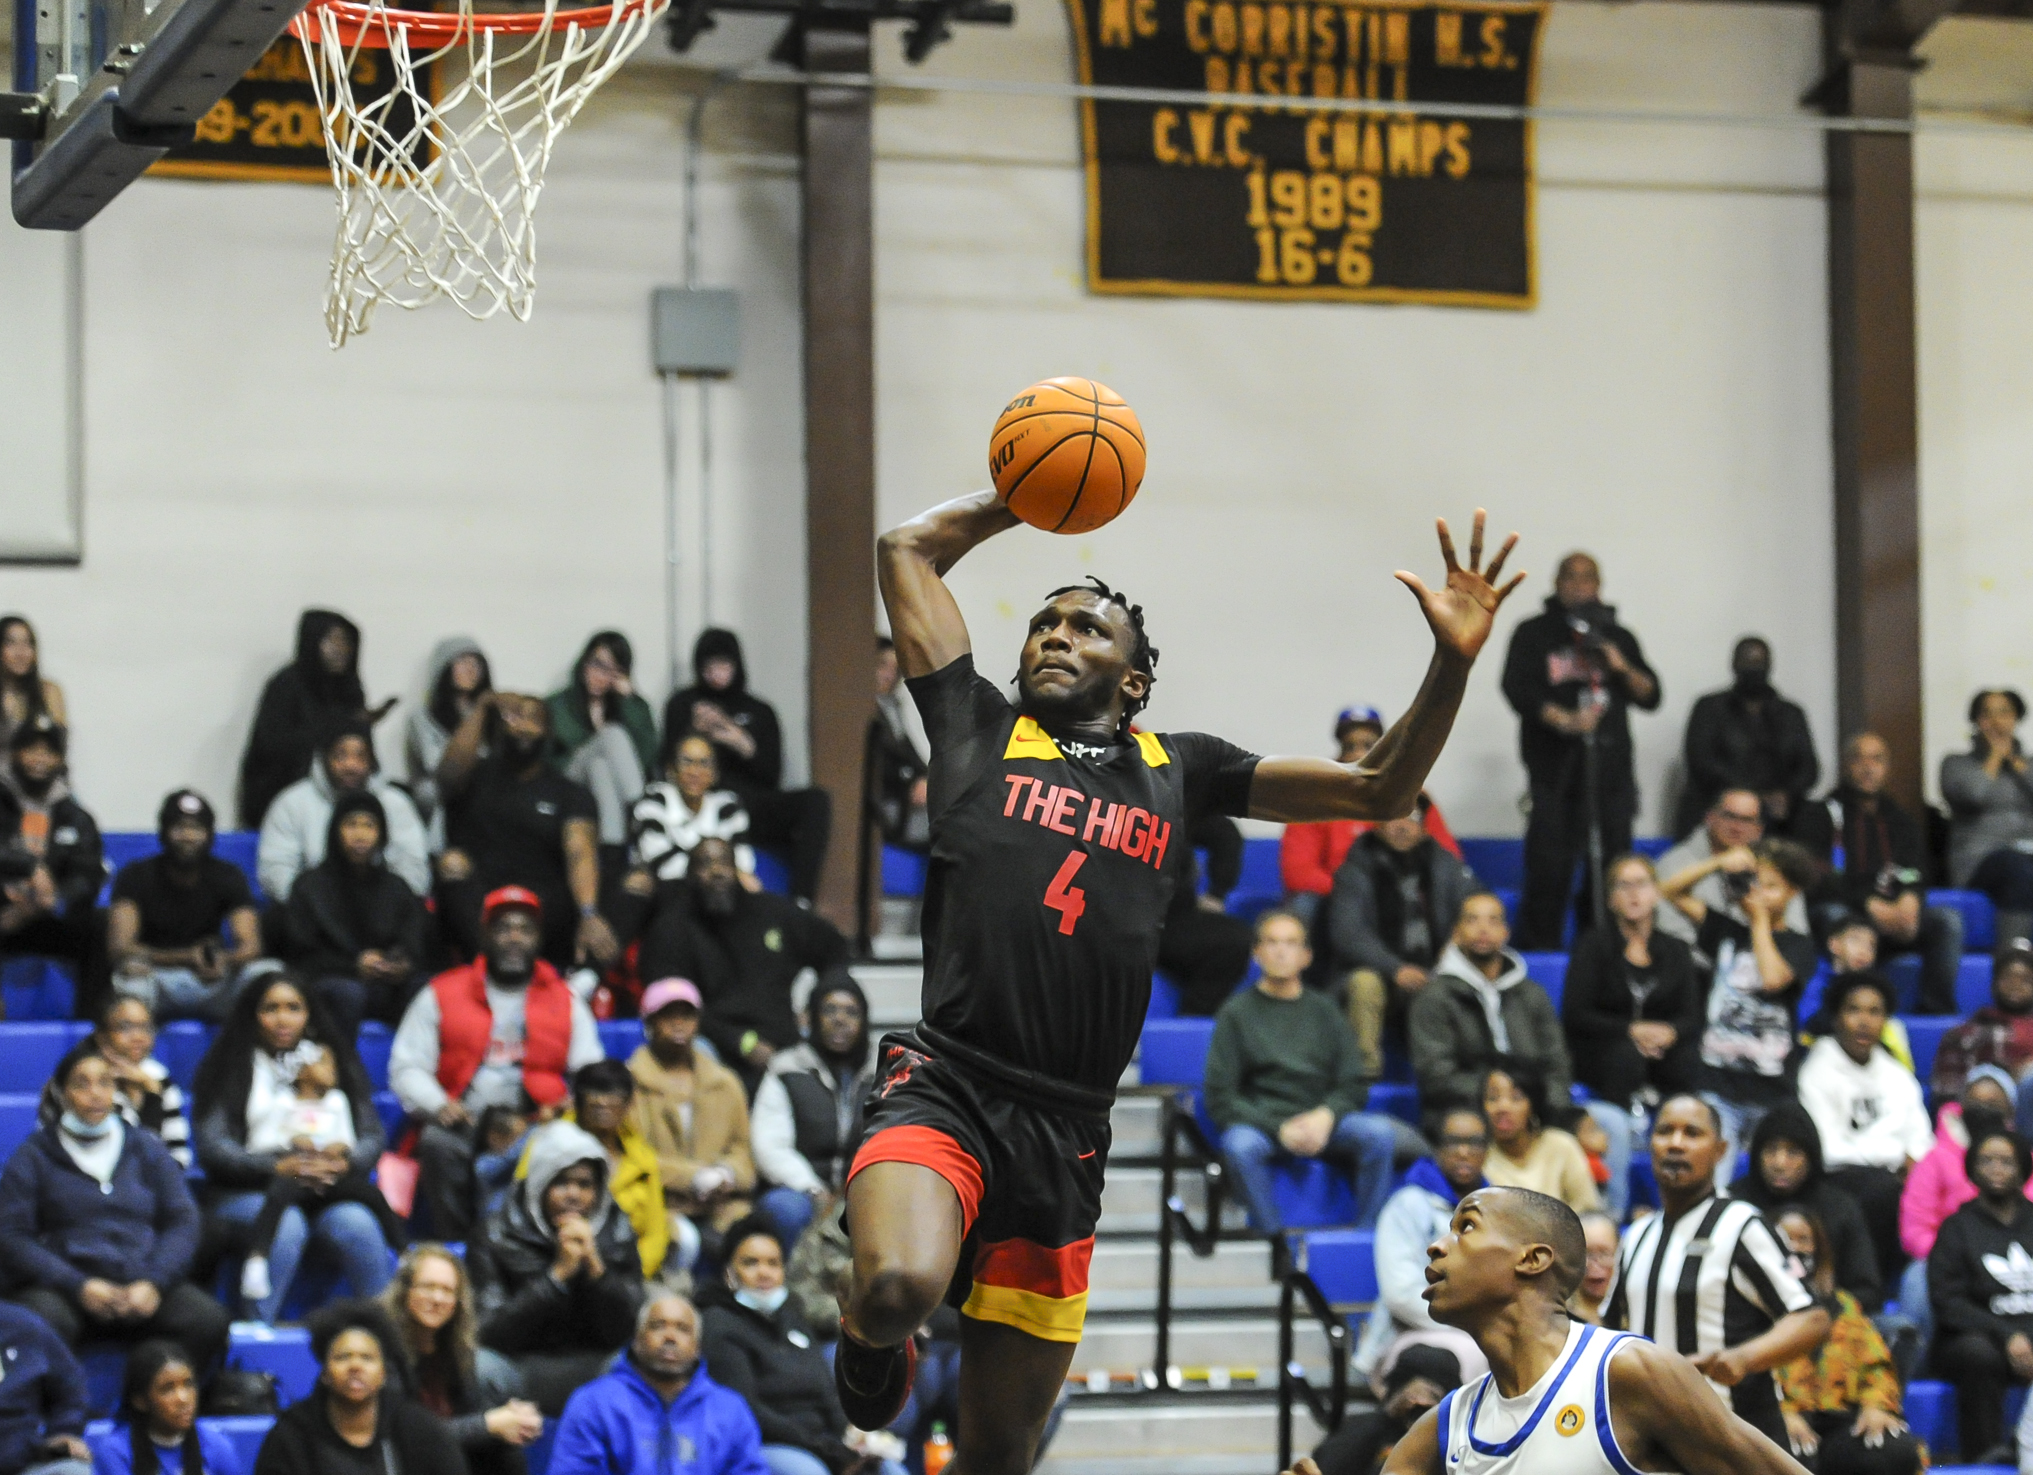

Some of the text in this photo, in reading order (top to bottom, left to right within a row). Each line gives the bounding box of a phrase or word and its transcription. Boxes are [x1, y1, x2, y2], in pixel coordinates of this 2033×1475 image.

[1185, 0, 1410, 65] CORRISTIN
[1205, 56, 1417, 122] BASEBALL
[1304, 118, 1472, 179] CHAMPS
[1245, 170, 1383, 231] 1989
[1254, 228, 1375, 287] 16-6
[1003, 774, 1171, 870] THE HIGH
[1043, 850, 1088, 936] 4
